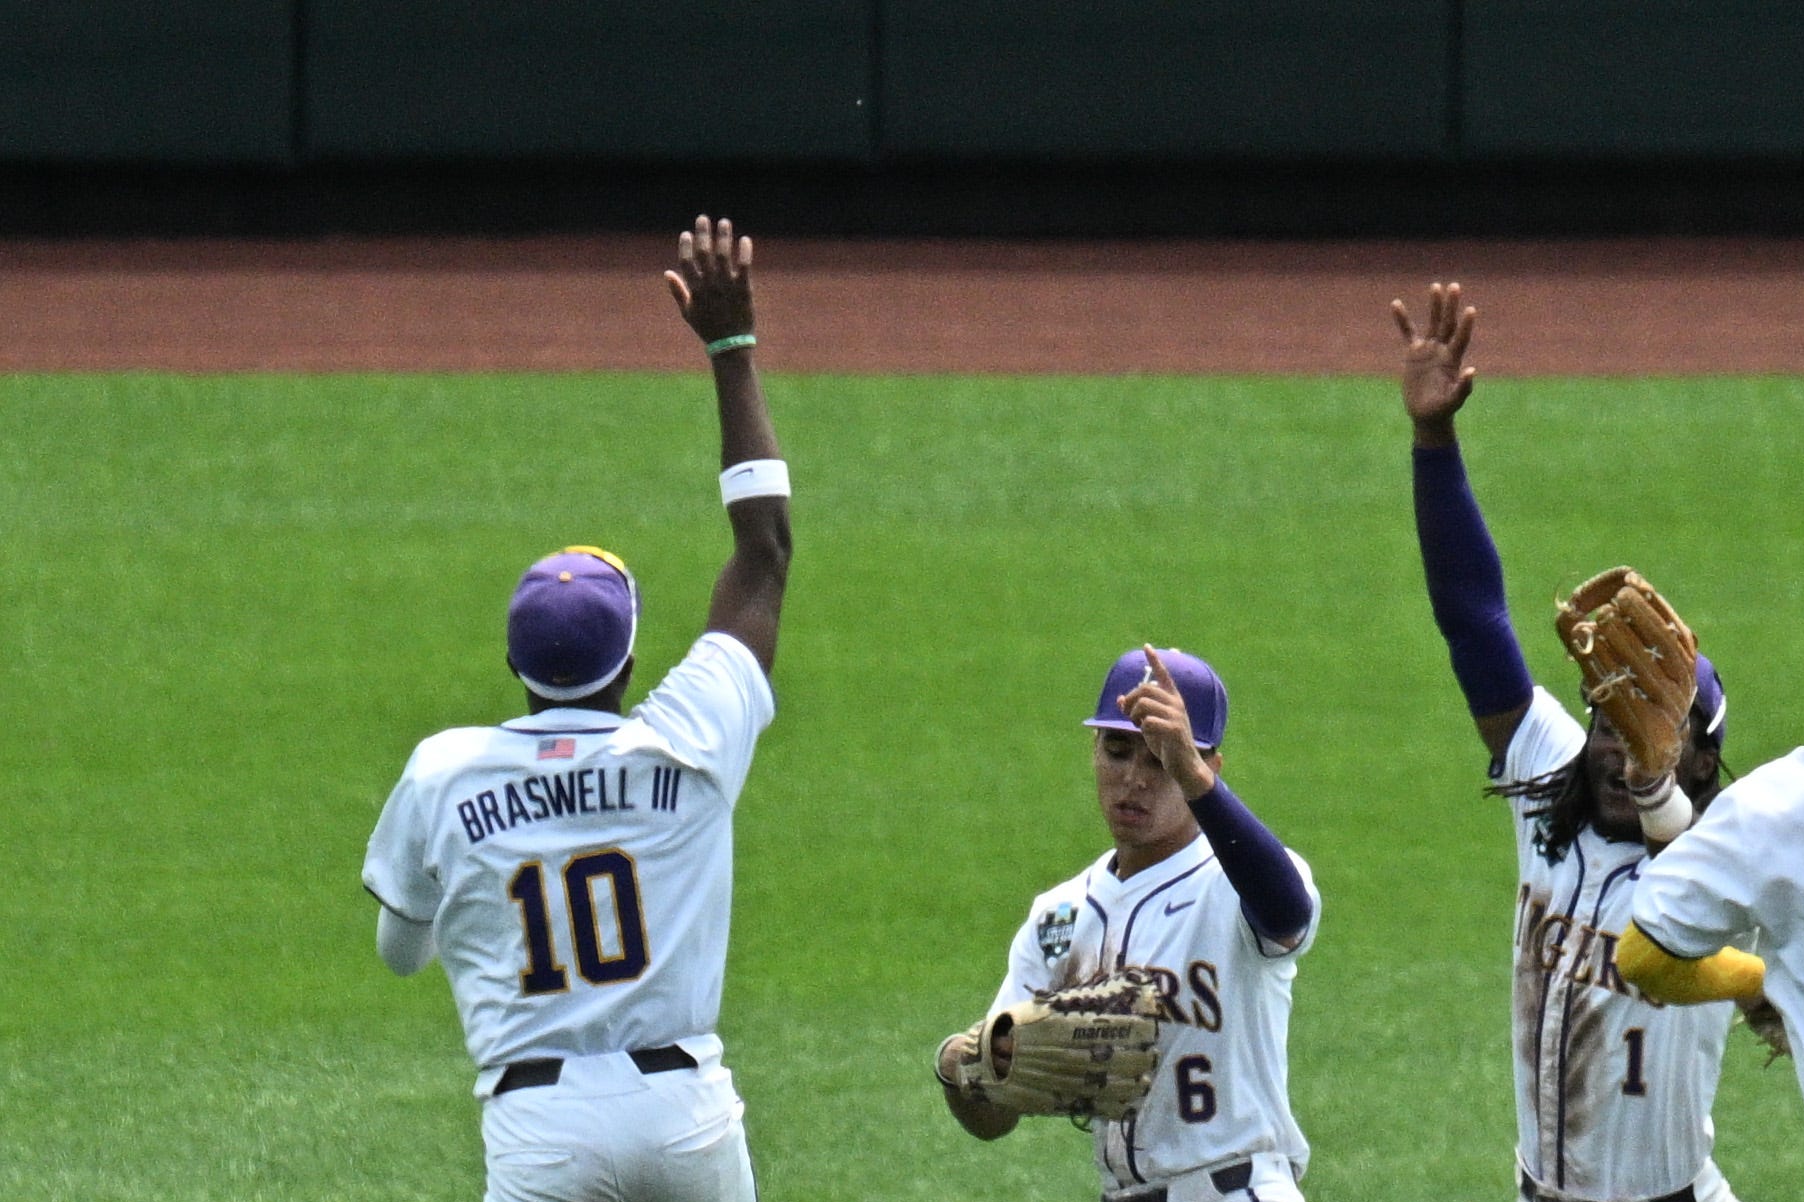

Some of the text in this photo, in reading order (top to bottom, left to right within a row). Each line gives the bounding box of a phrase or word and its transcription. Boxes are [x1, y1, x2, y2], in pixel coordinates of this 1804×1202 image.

[457, 765, 682, 844] BRASWELL III
[506, 847, 651, 995] 10
[1517, 883, 1666, 1010] IGER
[1175, 1053, 1217, 1124] 6
[1620, 1026, 1647, 1096] 1
